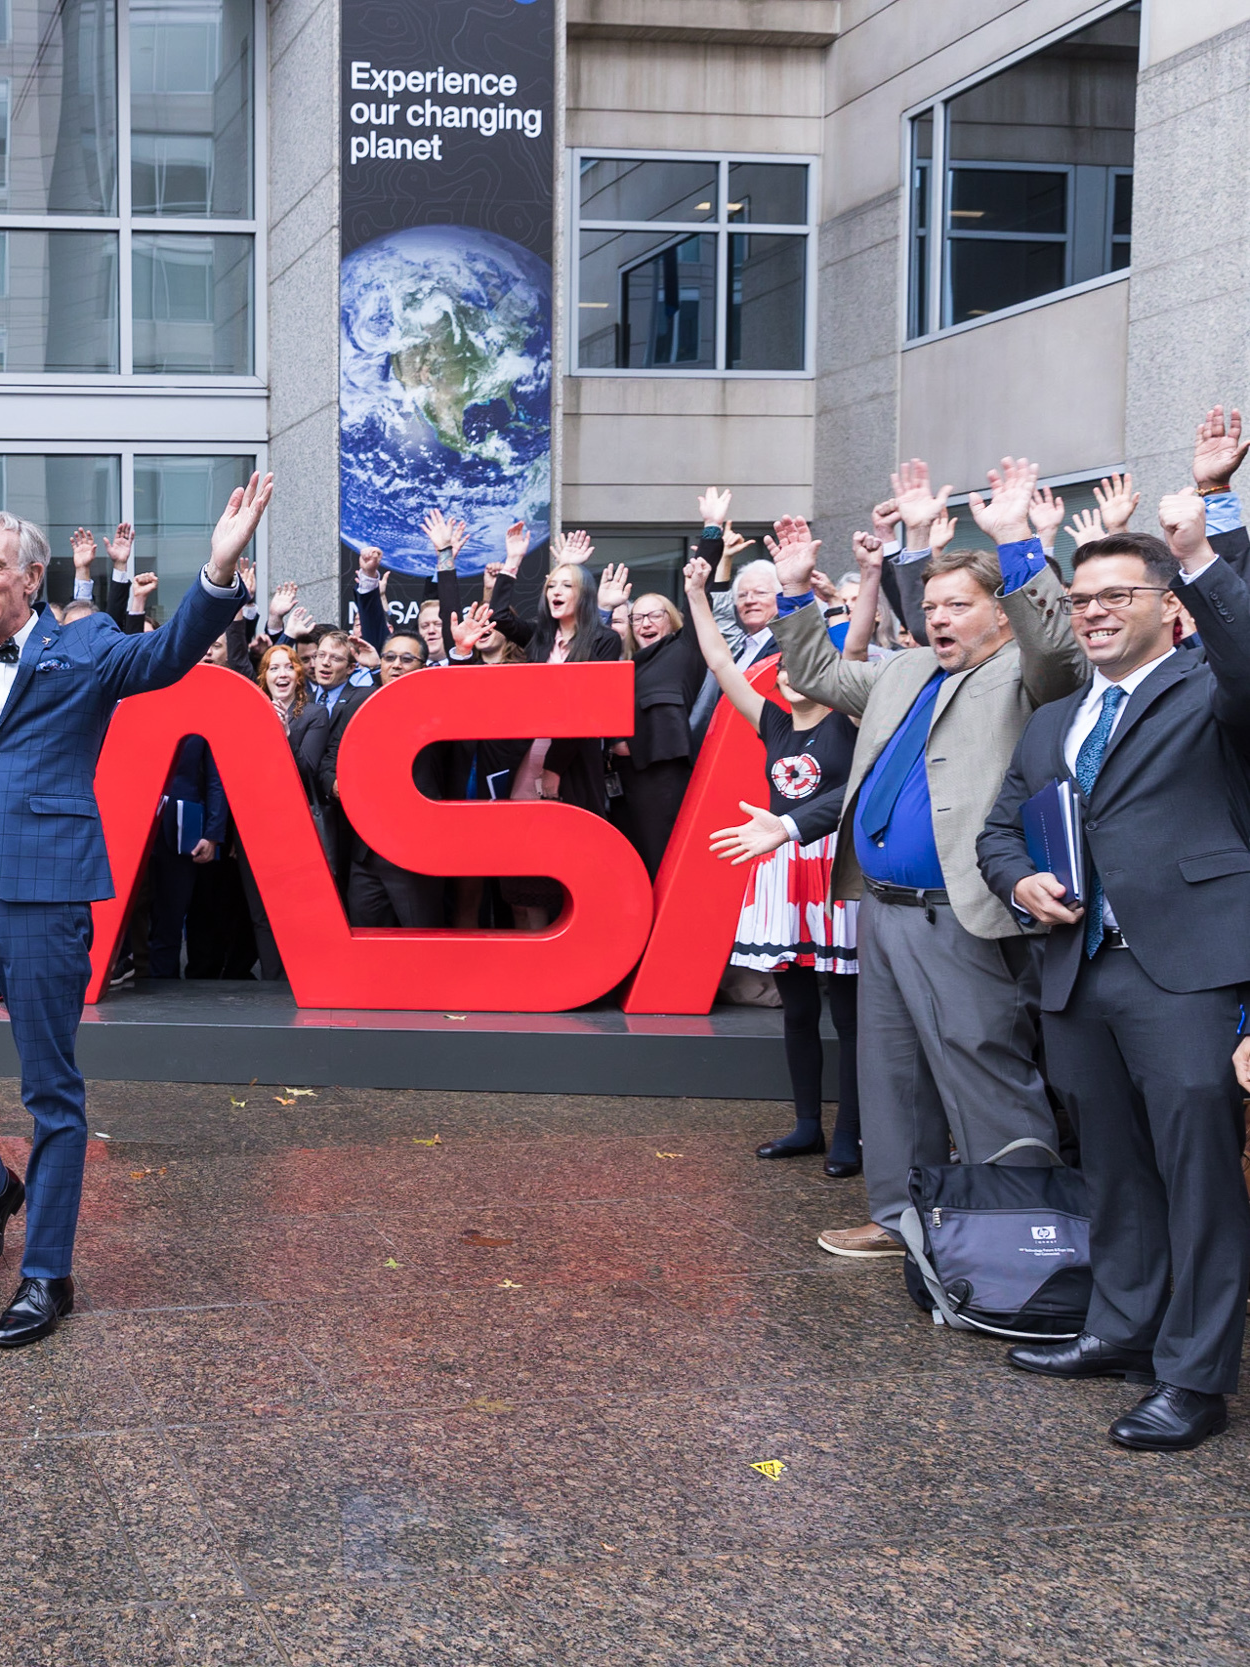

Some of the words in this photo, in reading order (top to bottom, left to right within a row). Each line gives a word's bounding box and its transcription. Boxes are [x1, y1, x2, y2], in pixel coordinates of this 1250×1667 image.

[351, 61, 517, 98] Experience
[350, 102, 400, 125] our
[406, 99, 542, 138] changing
[351, 130, 442, 164] planet
[348, 600, 420, 625] NSA
